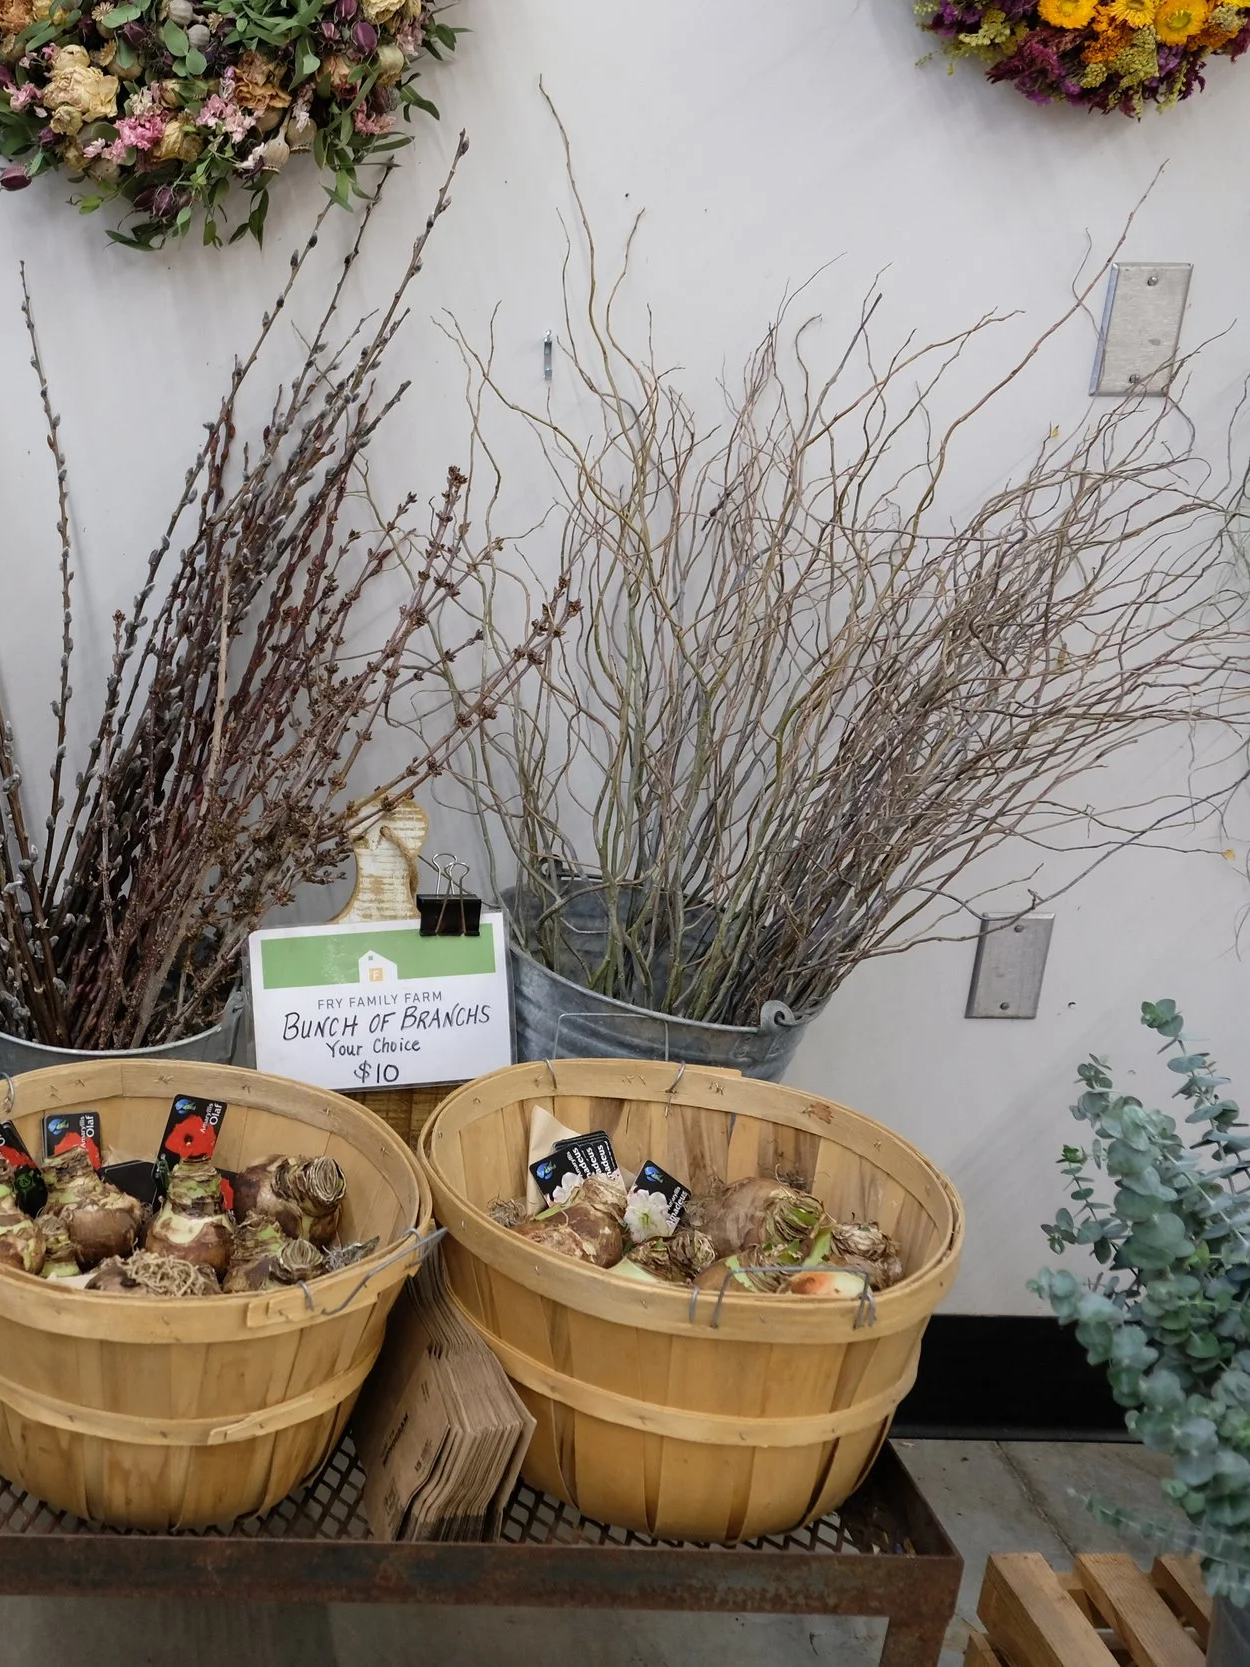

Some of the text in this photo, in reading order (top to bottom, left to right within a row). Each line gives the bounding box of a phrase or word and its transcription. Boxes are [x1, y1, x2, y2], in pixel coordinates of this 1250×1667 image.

[317, 991, 443, 1010] FRY FAMILY FARM
[283, 1003, 491, 1041] BUNCH OF BRANCHS
[326, 1037, 421, 1058] Your Choice
[353, 1060, 400, 1084] $10
[85, 1114, 95, 1138] Olaf
[209, 1102, 223, 1126] Olaf
[586, 1147, 602, 1175] adeus
